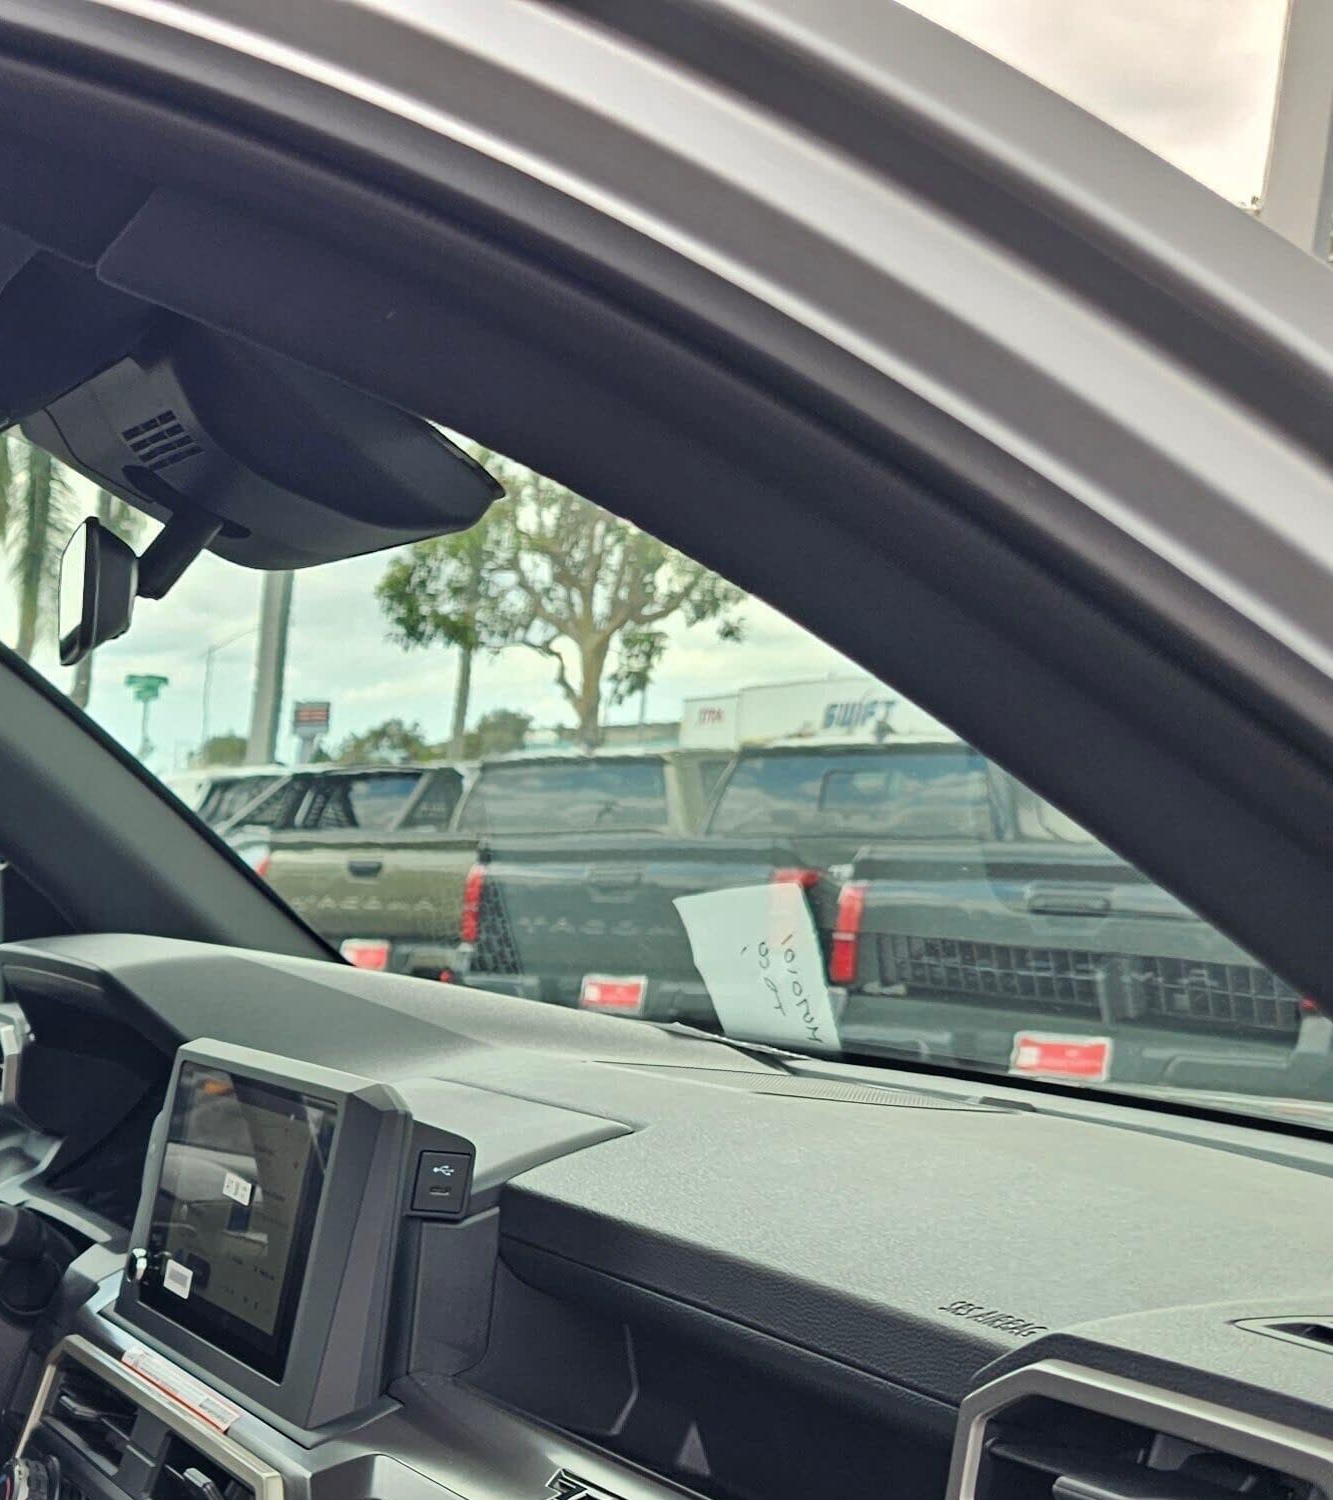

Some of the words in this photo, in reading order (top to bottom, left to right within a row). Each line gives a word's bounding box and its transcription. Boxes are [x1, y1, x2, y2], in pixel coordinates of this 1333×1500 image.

[823, 700, 897, 729] SWIFT
[516, 915, 678, 937] TACOM
[938, 1300, 984, 1316] SRS
[966, 1310, 1048, 1337] AIRBAG
